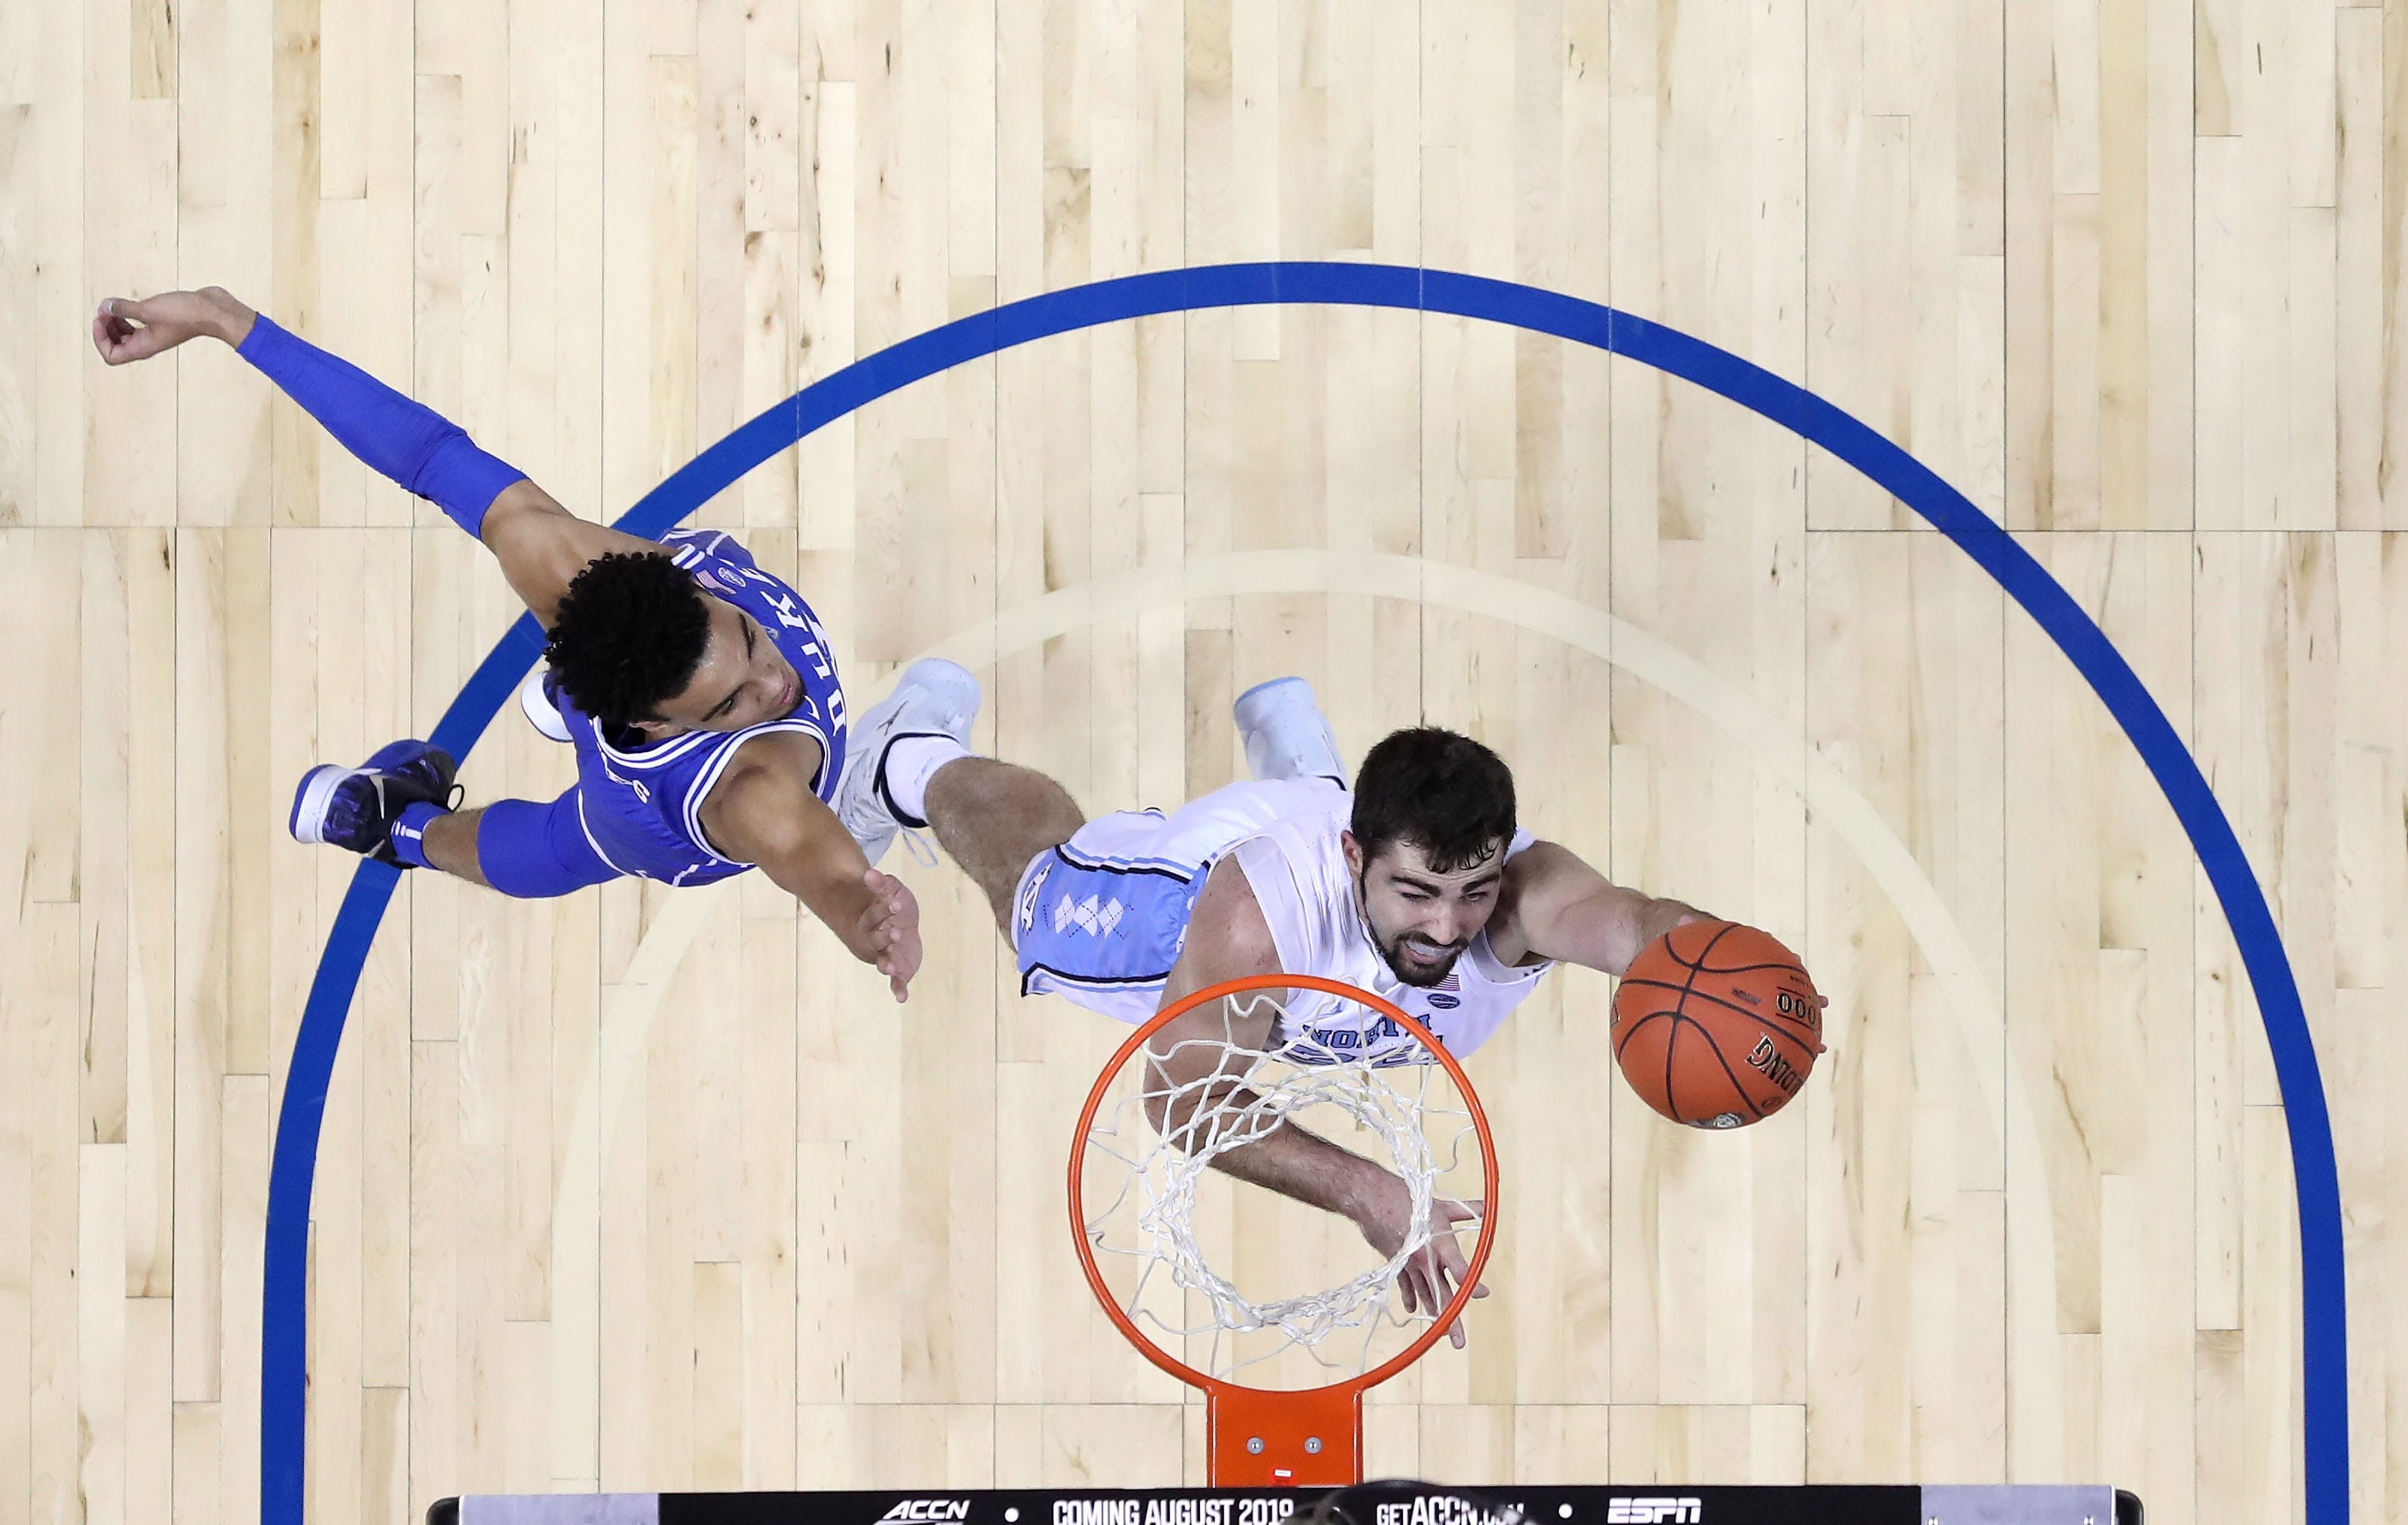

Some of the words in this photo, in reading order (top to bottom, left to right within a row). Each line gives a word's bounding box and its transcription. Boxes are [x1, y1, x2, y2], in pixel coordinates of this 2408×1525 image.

[882, 1499, 971, 1520] ACCN
[1053, 1500, 1139, 1525] COMING
[1144, 1499, 1234, 1525] AUGUST
[1607, 1497, 1702, 1524] ESPN
